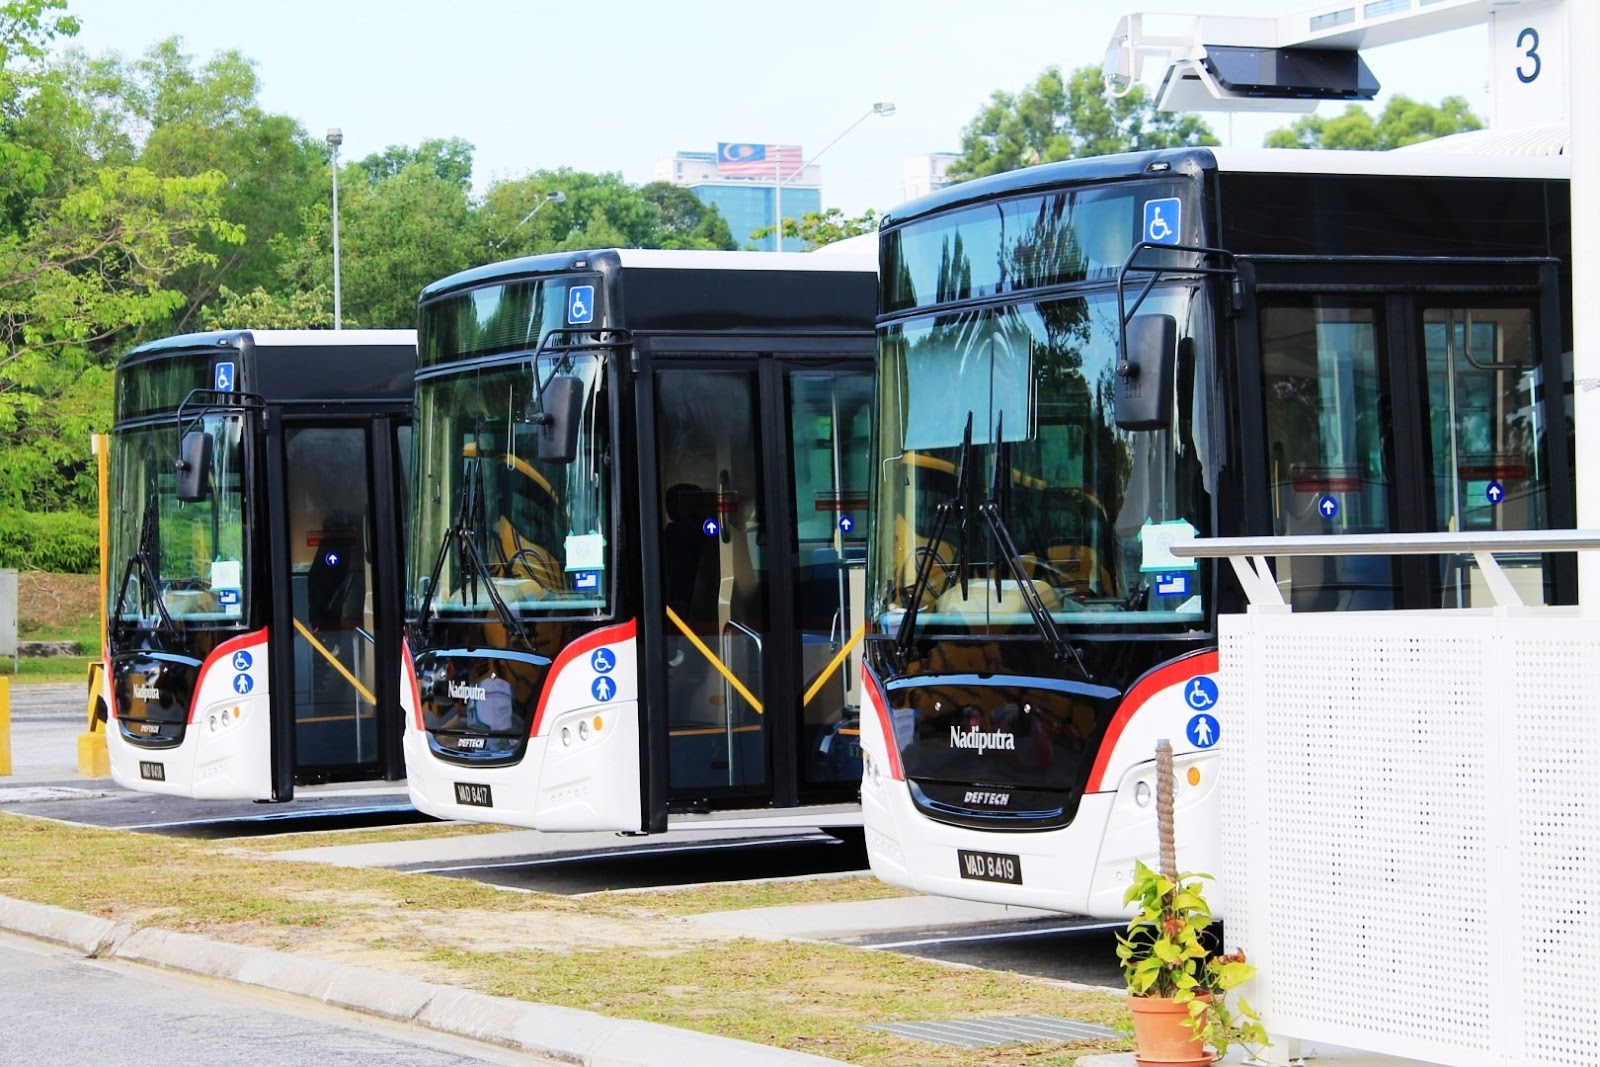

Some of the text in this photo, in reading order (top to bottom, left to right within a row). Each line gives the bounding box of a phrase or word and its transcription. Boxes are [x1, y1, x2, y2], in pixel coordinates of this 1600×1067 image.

[1516, 27, 1541, 83] 3
[133, 683, 160, 703] Nadiputra
[448, 680, 486, 704] Nadiputra
[458, 738, 485, 749] DEFTECH
[950, 725, 1015, 755] Nadiputra
[457, 784, 488, 804] VAD 8417
[964, 791, 1010, 805] DEFTECH
[964, 854, 1015, 880] VAD 8419
